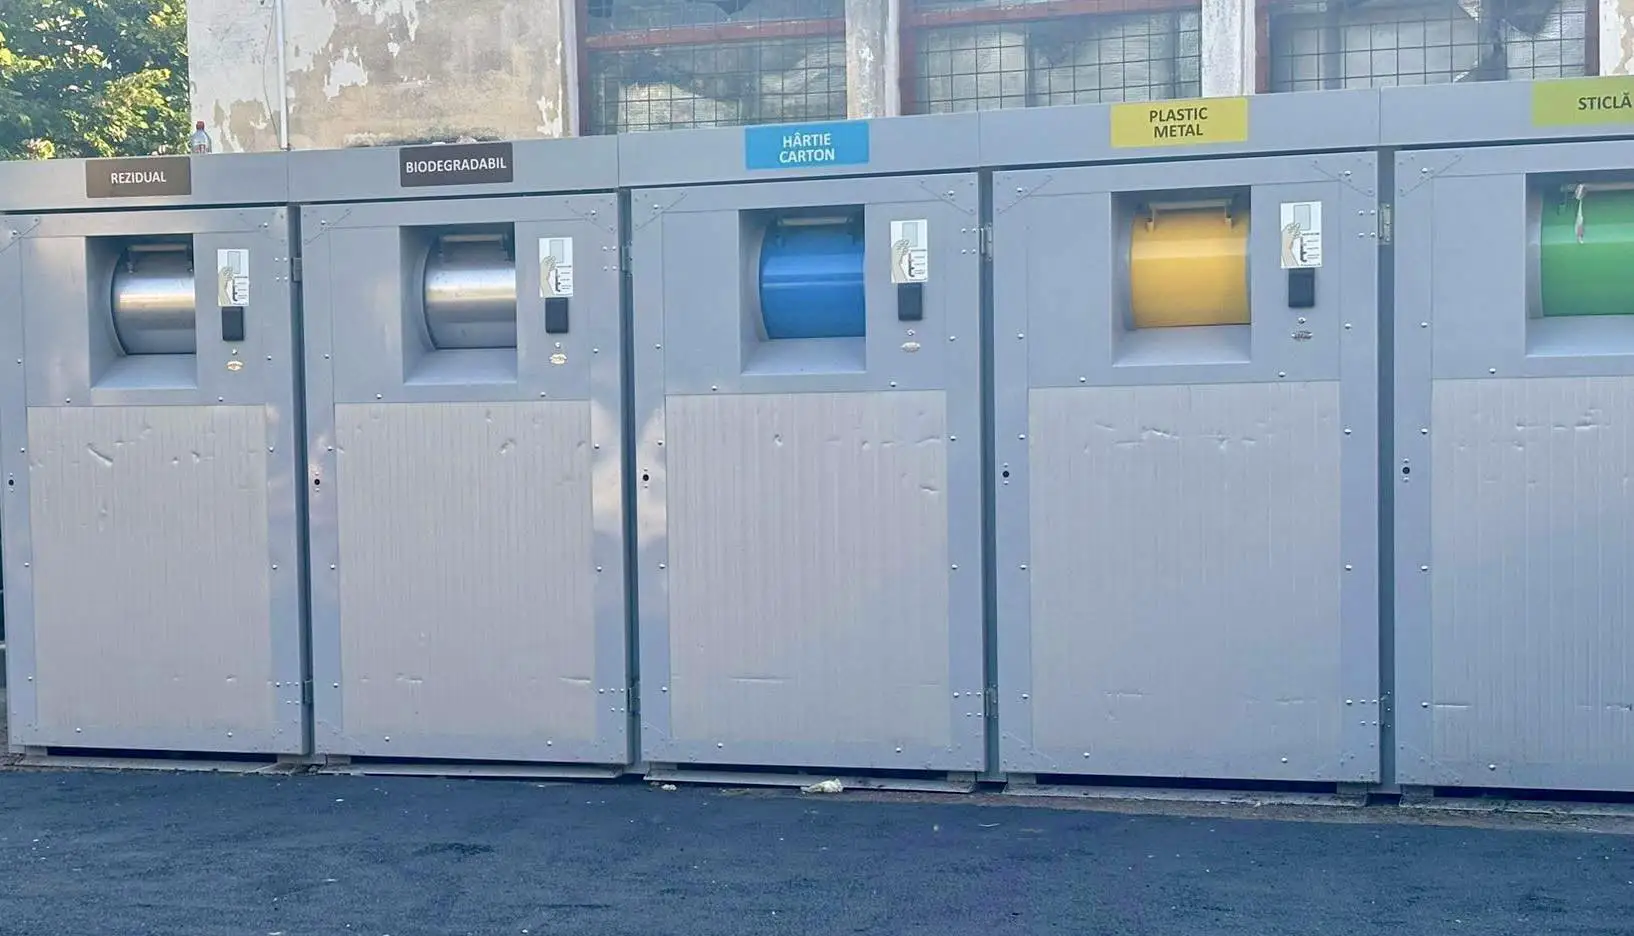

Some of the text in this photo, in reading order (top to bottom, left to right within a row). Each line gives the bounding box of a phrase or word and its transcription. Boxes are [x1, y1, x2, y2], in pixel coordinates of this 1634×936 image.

[1578, 92, 1632, 110] STICLĂ
[1149, 107, 1208, 122] PLASTIC
[1154, 124, 1203, 138] METAL
[783, 132, 832, 148] HÂRTIE
[779, 148, 835, 163] CARTON
[406, 157, 507, 173] BIODEGRADABIL
[111, 171, 166, 184] REZIDUAL
